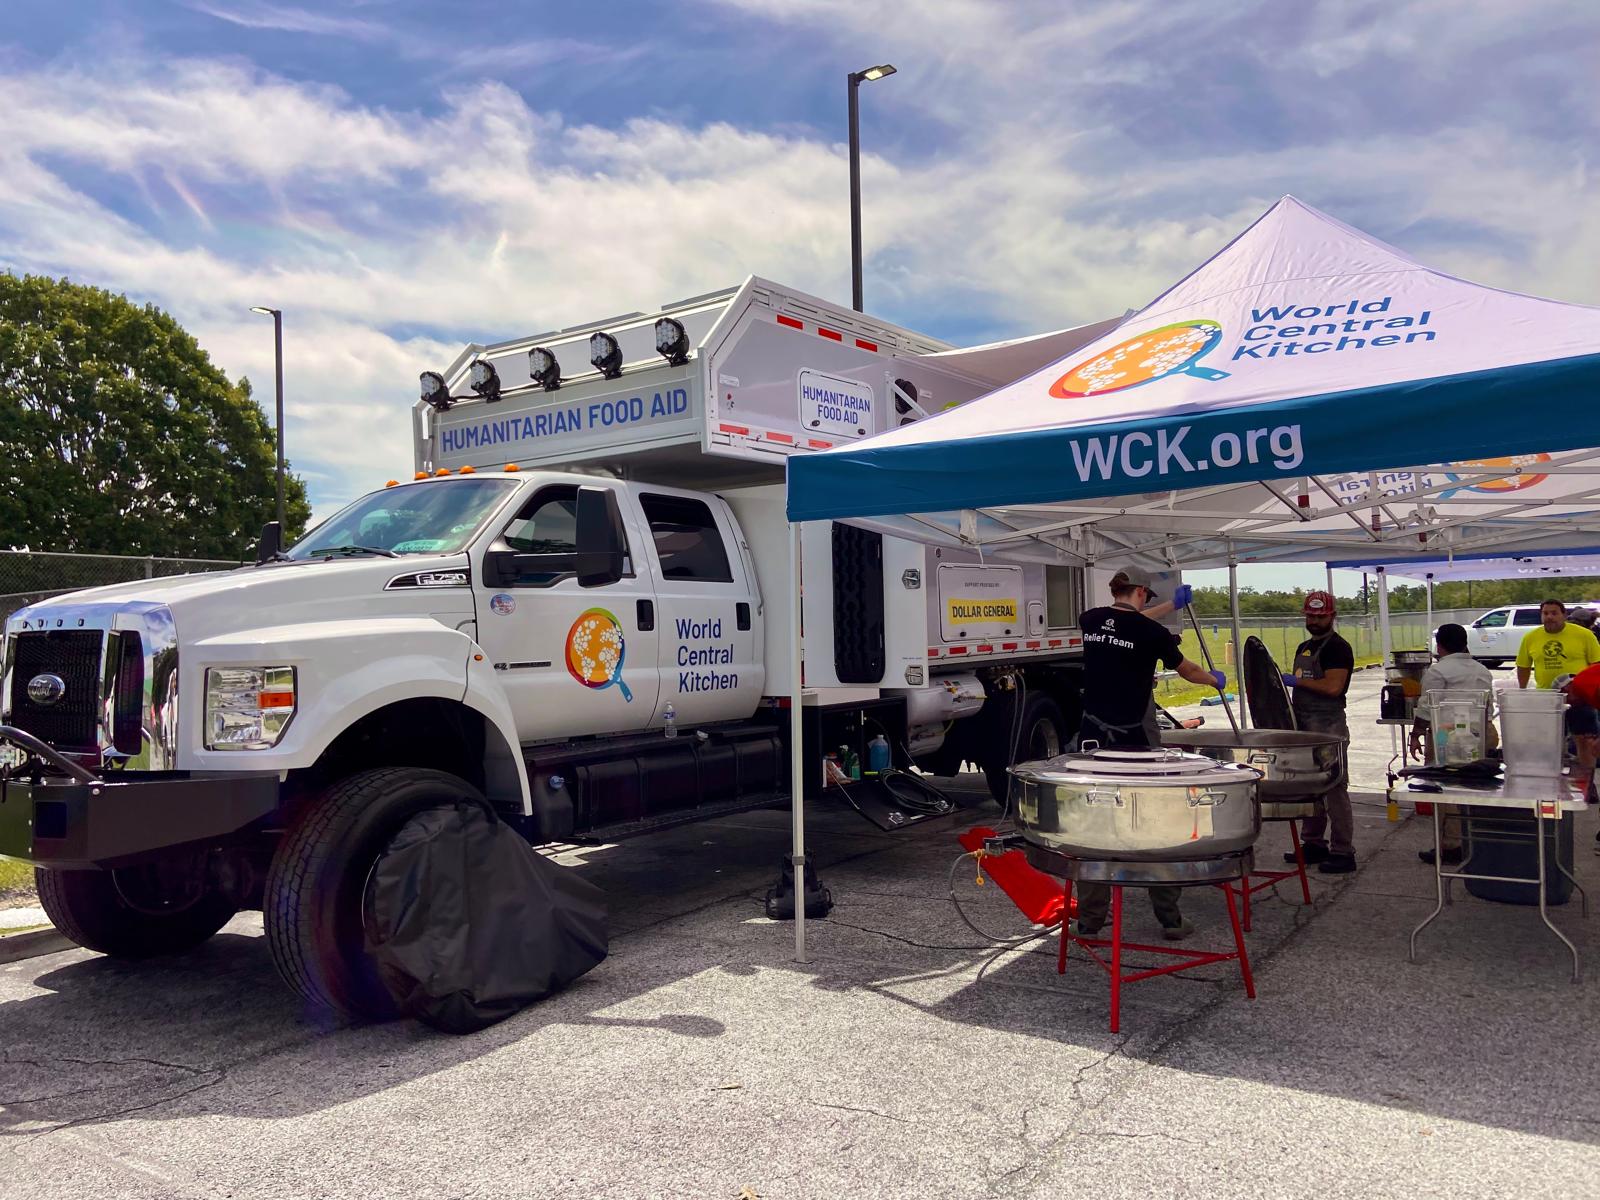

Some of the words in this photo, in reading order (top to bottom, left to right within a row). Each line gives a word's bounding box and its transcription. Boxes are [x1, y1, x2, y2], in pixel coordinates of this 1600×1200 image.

[1251, 296, 1393, 324] World
[1243, 311, 1432, 342] Central
[1231, 331, 1437, 361] Kitchen
[802, 385, 871, 413] HUMANITARIAN
[442, 407, 581, 453] HUMANITARIAN
[588, 397, 644, 429] FOOD
[650, 388, 688, 418] AID
[818, 404, 842, 421] FOOD
[843, 410, 859, 425] AID
[1069, 424, 1304, 482] WCK.org
[952, 605, 982, 618] DOLLAR
[983, 605, 1014, 617] GENERAL
[675, 618, 721, 639] World
[1083, 633, 1107, 643] Relief
[1108, 635, 1134, 649] Team
[677, 643, 734, 667] Central
[679, 670, 738, 693] Kitchen
